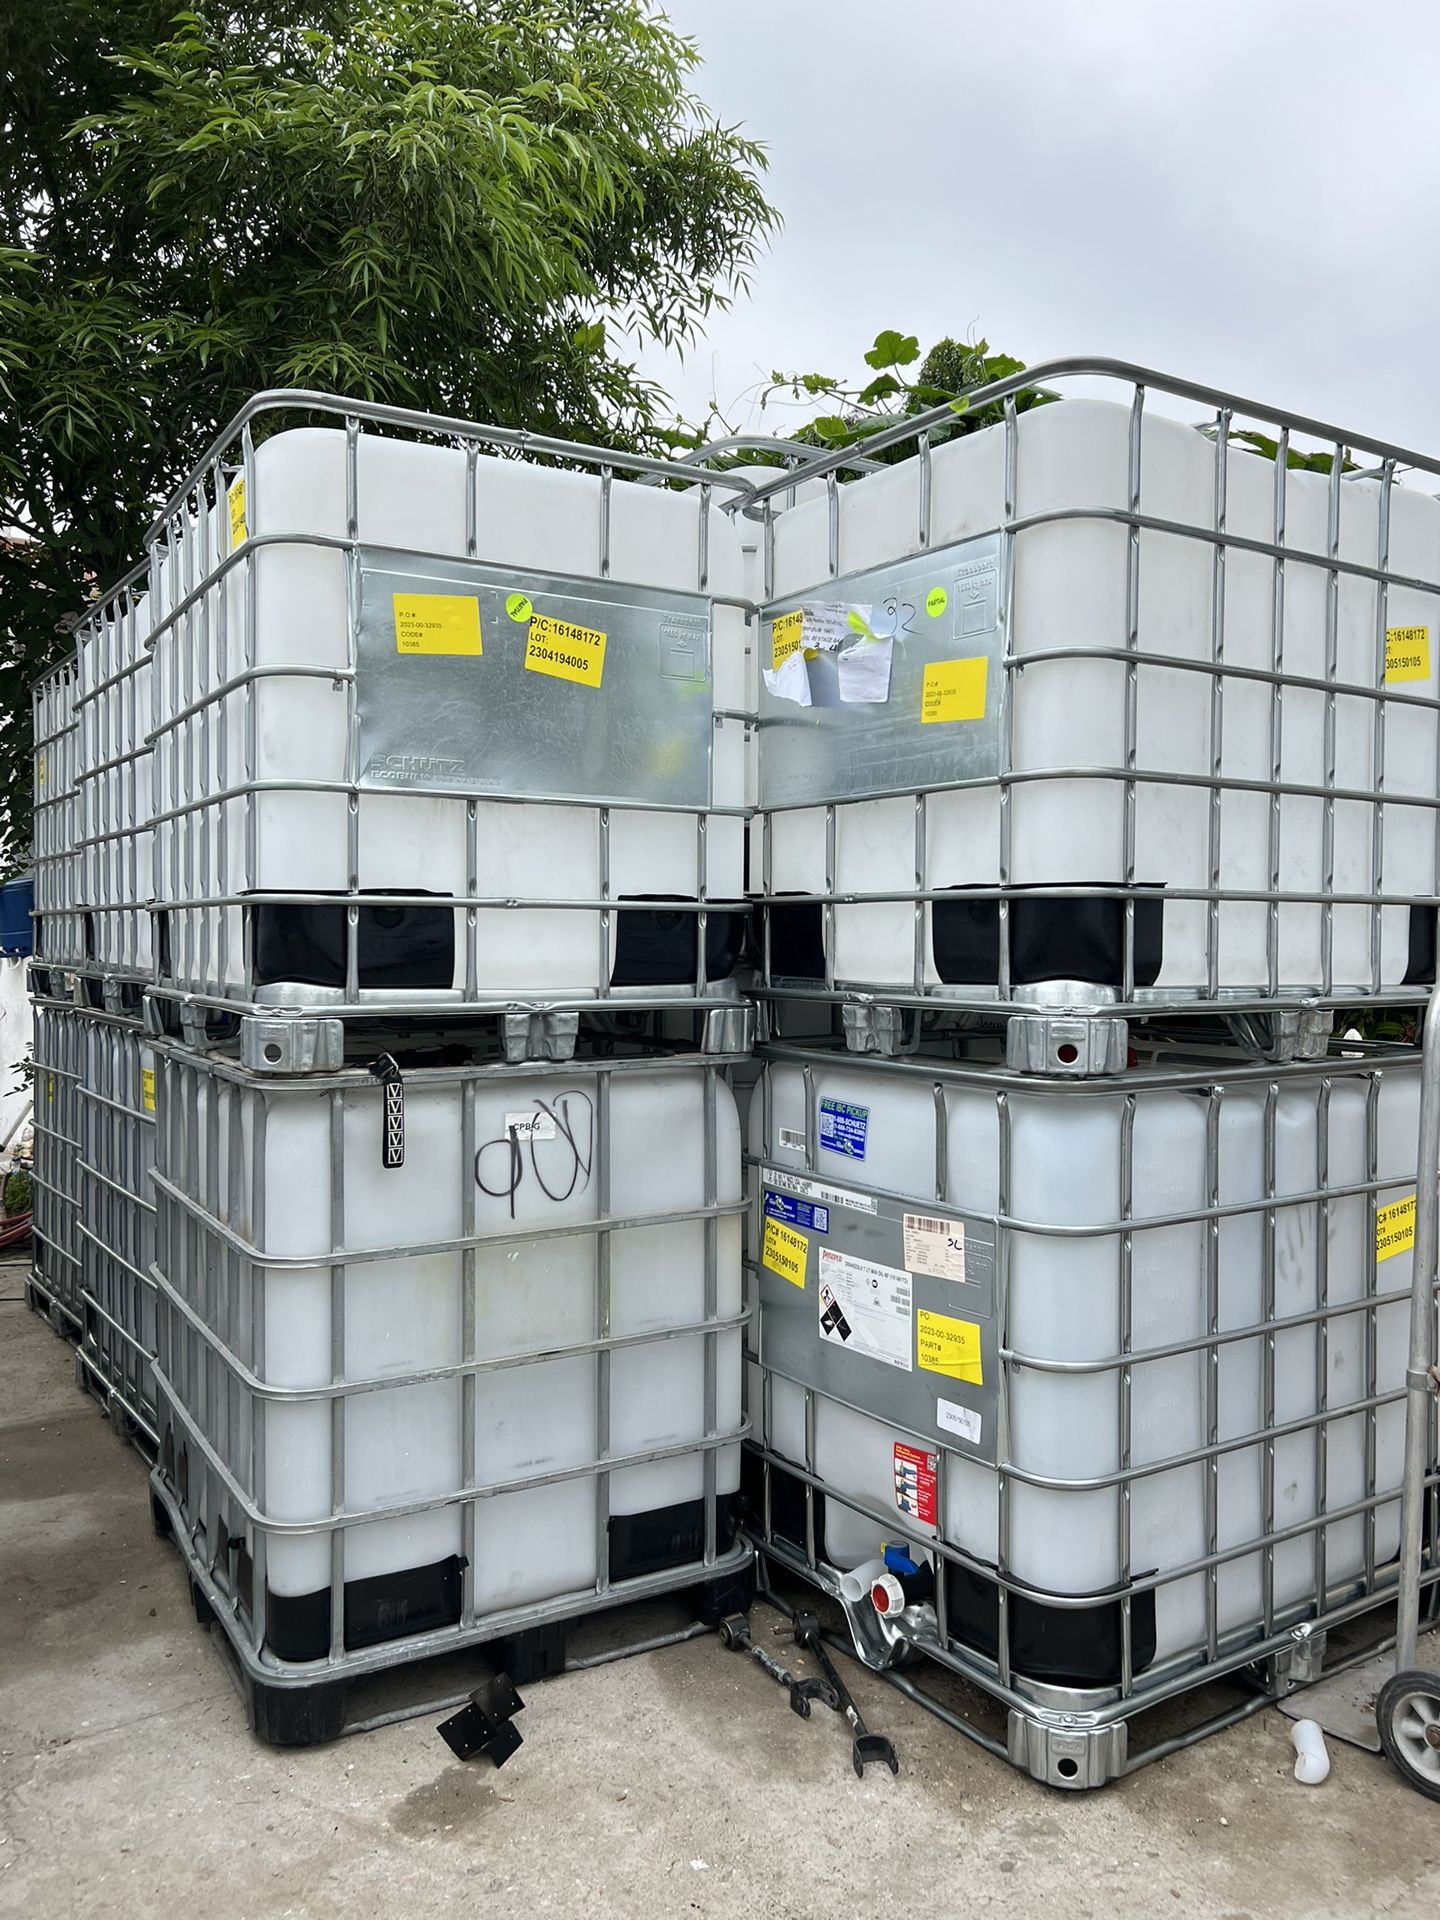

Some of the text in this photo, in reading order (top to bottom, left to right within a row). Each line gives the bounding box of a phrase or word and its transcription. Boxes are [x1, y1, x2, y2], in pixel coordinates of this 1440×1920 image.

[510, 597, 529, 618] PARTIAL
[928, 597, 946, 607] PARTIAL
[529, 615, 601, 646] P/C:16148172
[530, 632, 549, 644] LOT:
[529, 645, 589, 671] 2304194005
[1385, 656, 1421, 669] 305150105
[821, 1098, 836, 1111] FREE
[780, 1230, 808, 1254] 16148172
[1376, 1226, 1413, 1250] 2305150105
[765, 1246, 799, 1274] 2305150105
[920, 1310, 930, 1321] PO
[920, 1325, 966, 1345] 2023-00-32935
[920, 1339, 942, 1352] PART#
[921, 1353, 939, 1366] 10385
